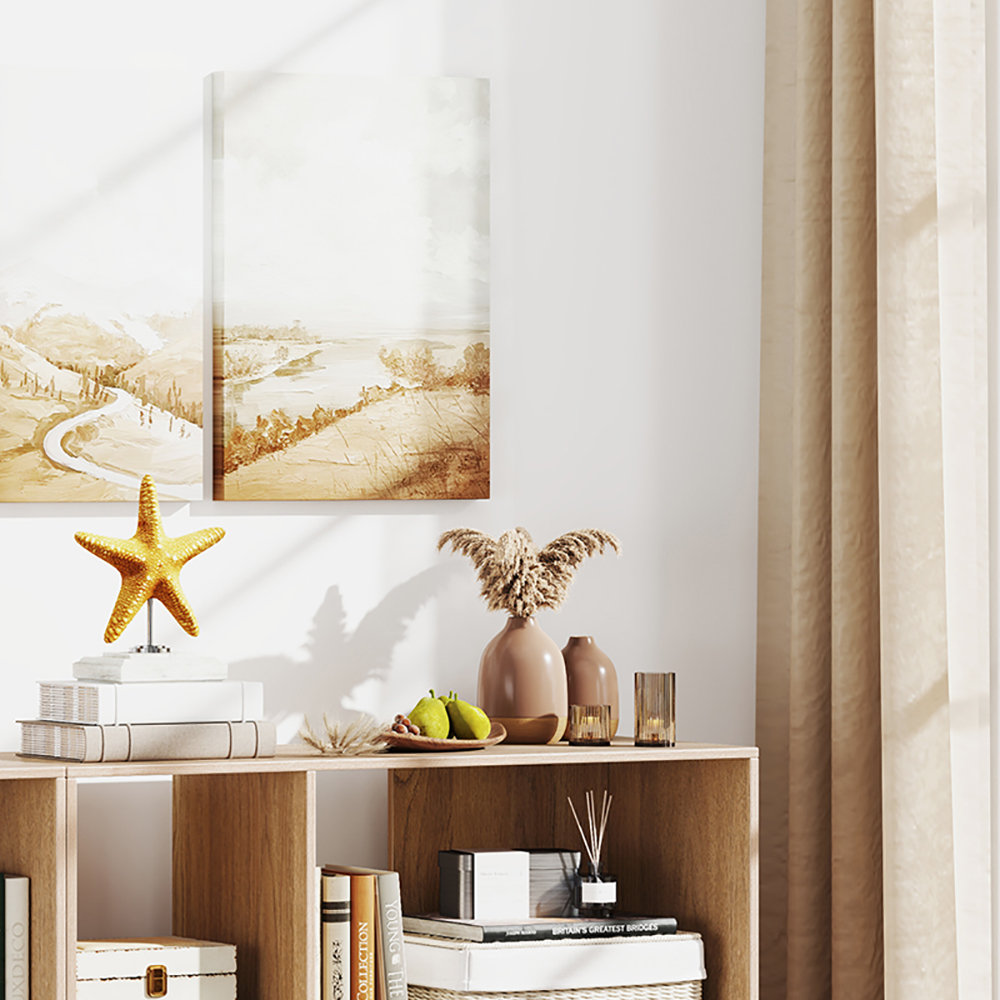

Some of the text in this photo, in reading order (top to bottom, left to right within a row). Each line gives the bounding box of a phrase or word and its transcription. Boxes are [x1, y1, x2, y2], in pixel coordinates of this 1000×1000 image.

[384, 899, 401, 953] YOUNG
[552, 922, 658, 936] BRITAIN'S GREATEST BRIDGES
[387, 968, 404, 999] THE
